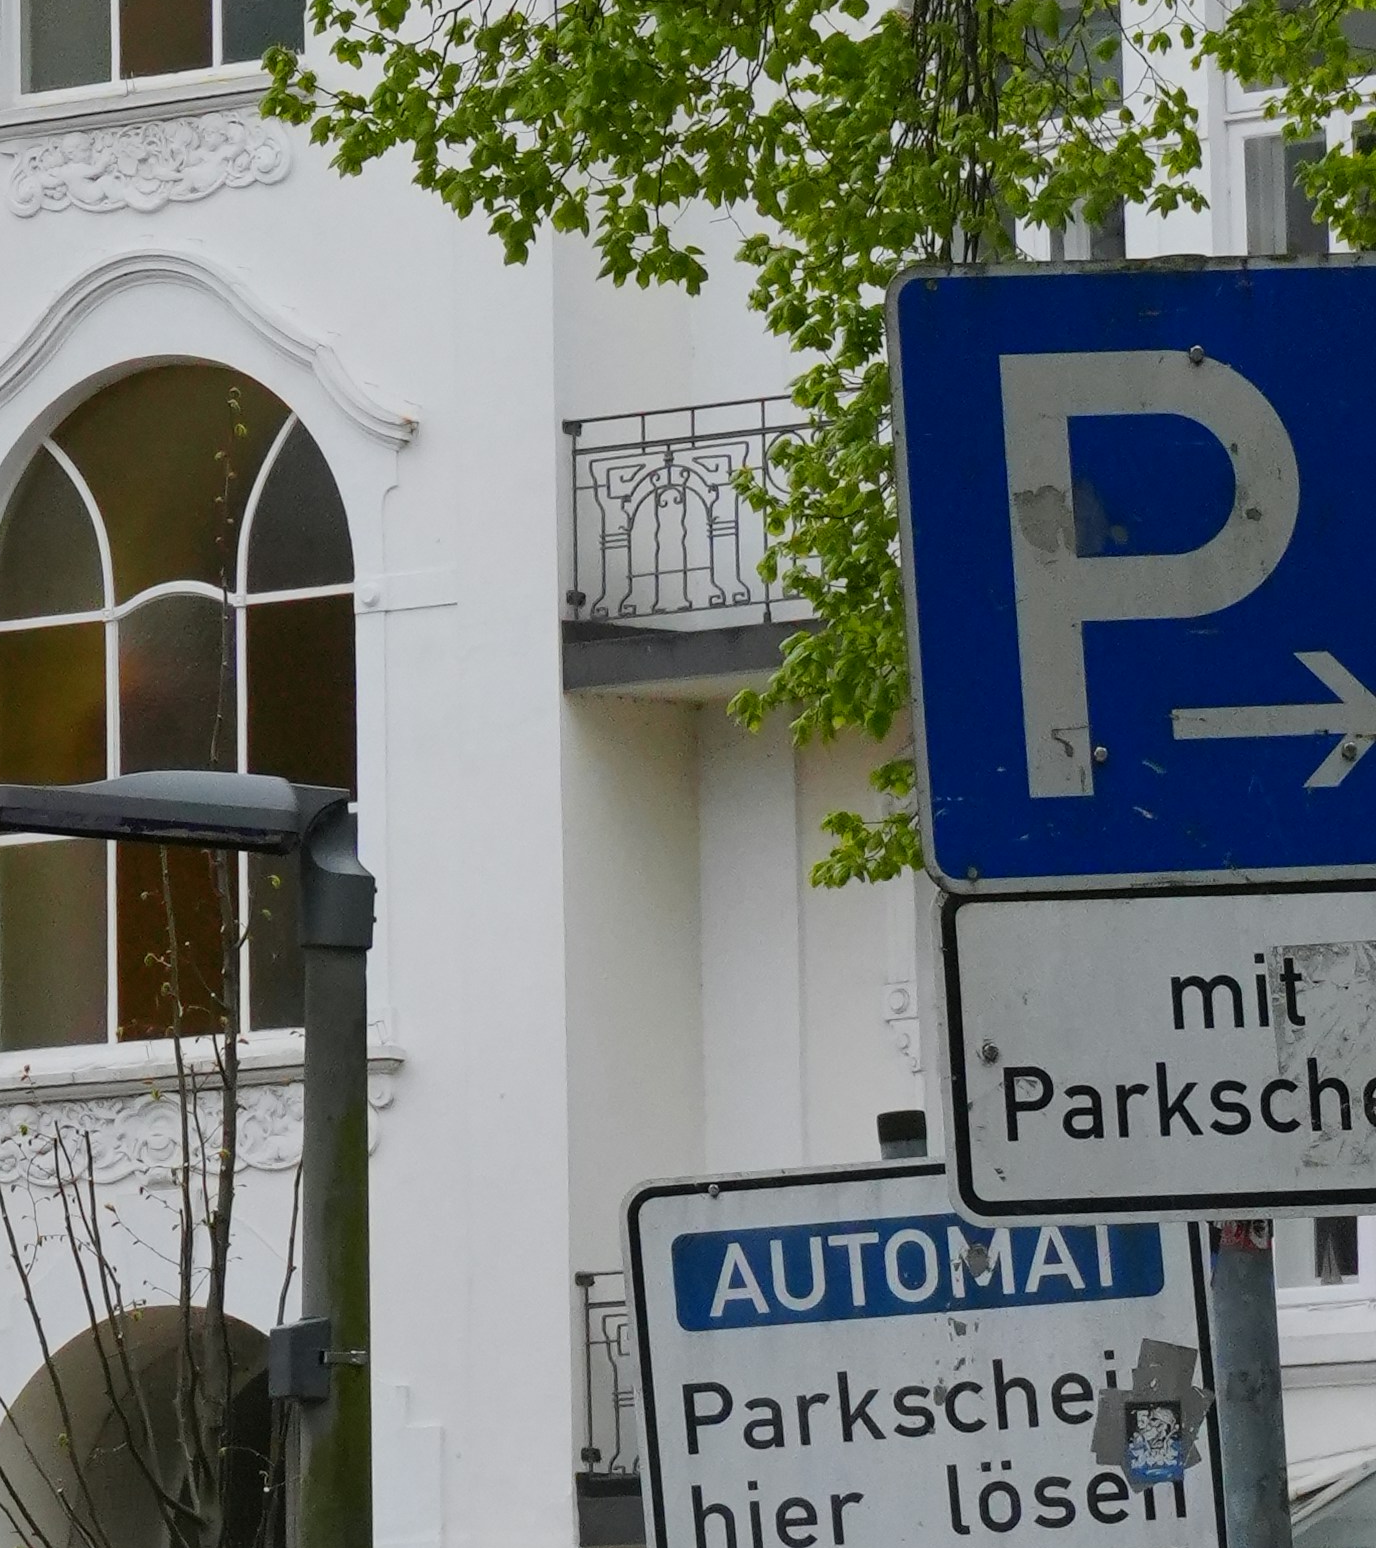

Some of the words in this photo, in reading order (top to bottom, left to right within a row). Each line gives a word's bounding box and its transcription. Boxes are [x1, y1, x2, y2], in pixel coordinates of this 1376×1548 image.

[998, 351, 1301, 797] P
[1171, 952, 1306, 1030] mit
[681, 1349, 1119, 1456] Parkschei
[947, 1460, 1188, 1536] lösen
